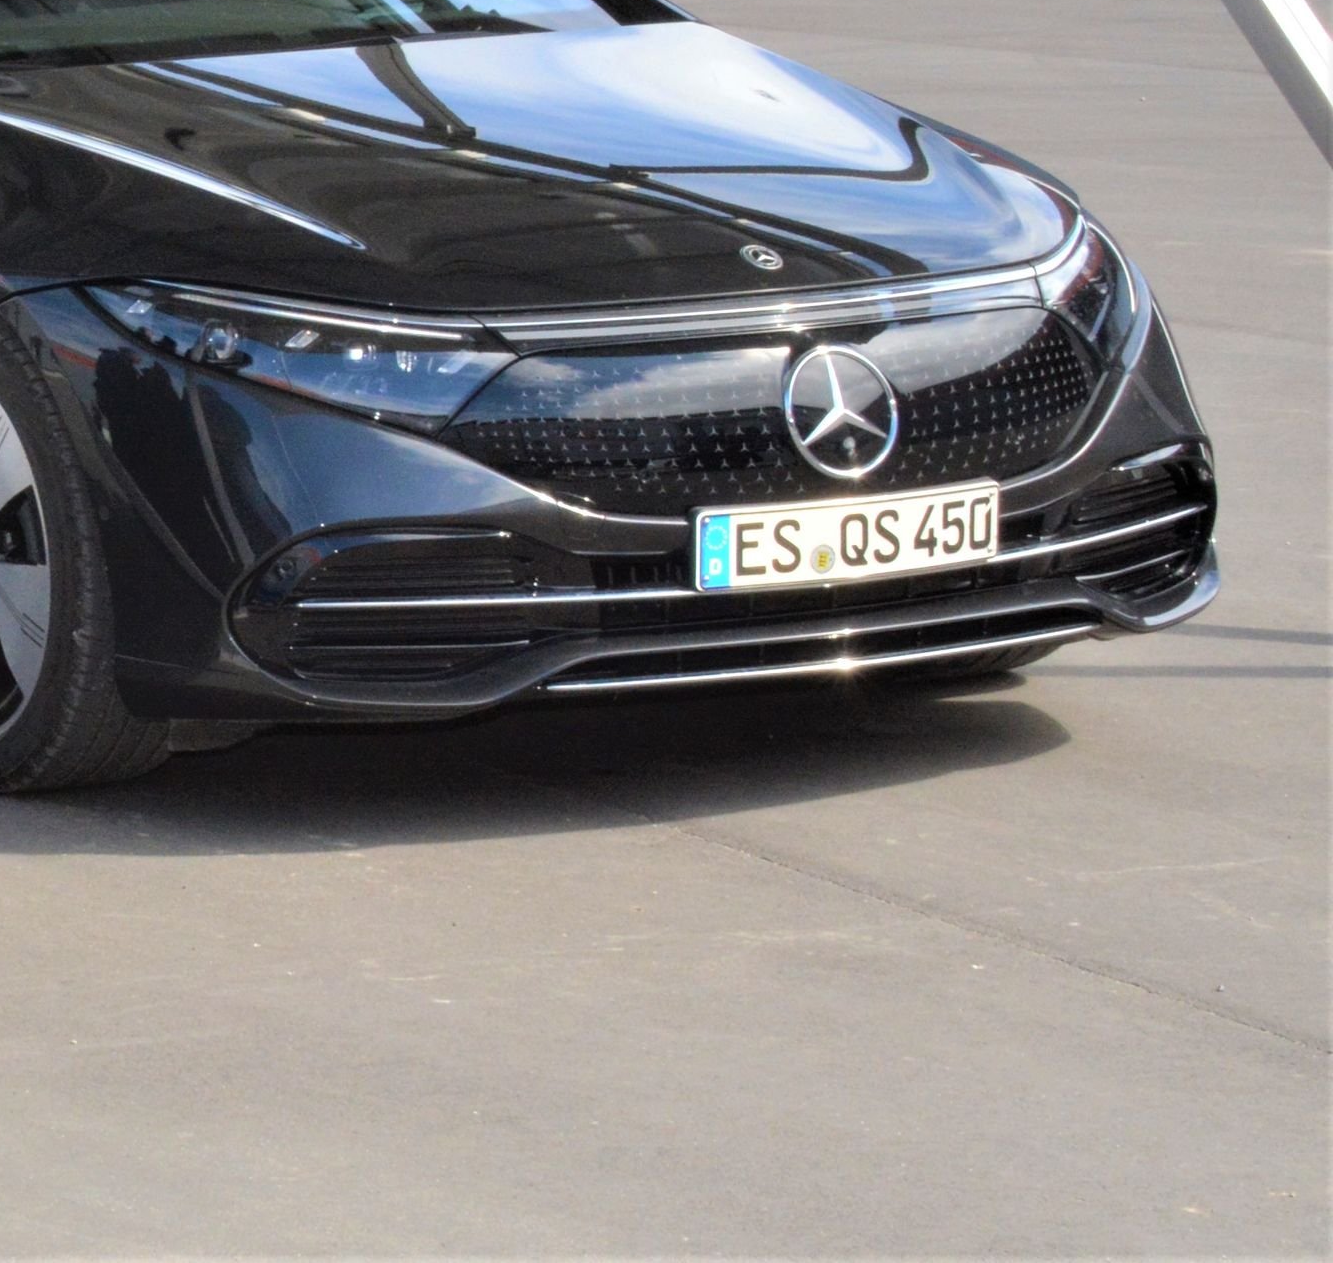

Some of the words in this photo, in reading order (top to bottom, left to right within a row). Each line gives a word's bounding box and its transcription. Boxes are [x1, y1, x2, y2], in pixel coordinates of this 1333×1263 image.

[736, 519, 801, 576] ES
[840, 509, 900, 566] QS
[913, 496, 992, 557] 450
[708, 558, 722, 575] D
